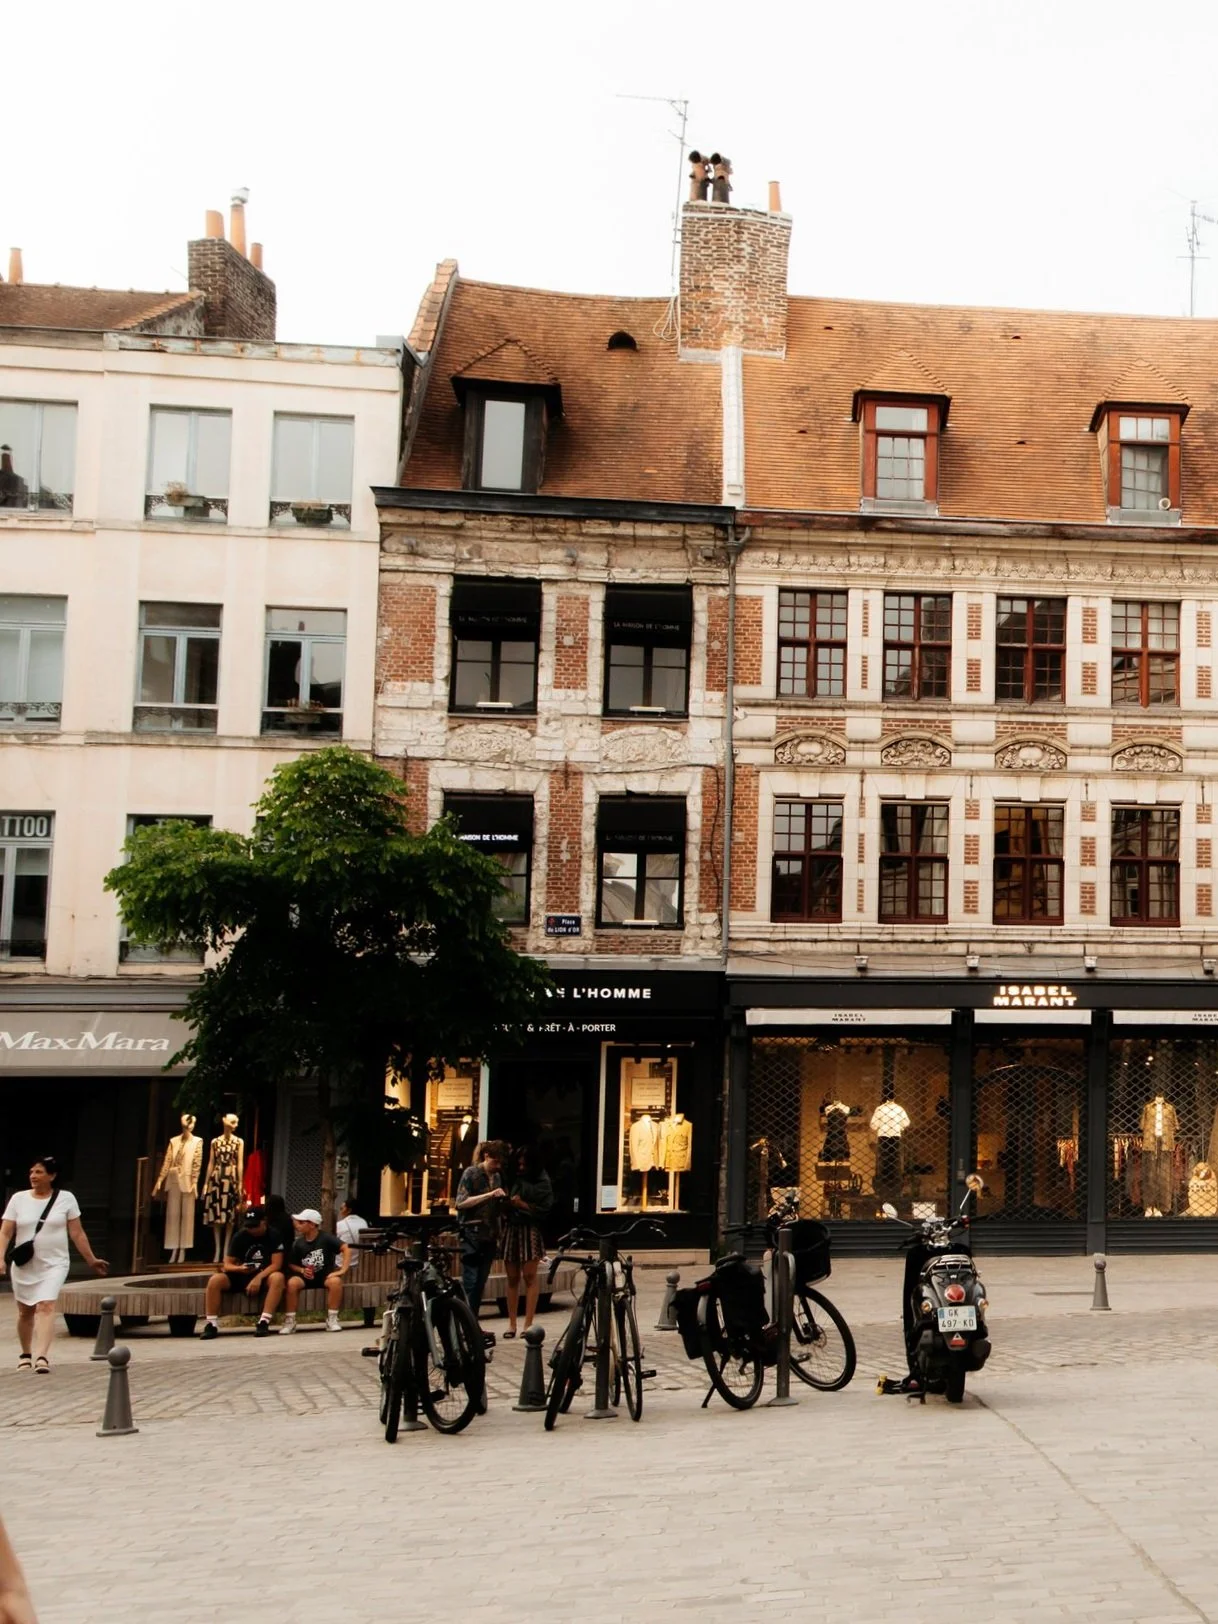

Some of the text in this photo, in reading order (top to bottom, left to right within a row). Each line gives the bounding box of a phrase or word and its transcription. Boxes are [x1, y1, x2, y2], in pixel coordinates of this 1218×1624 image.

[0, 816, 48, 837] TTOO
[573, 987, 652, 999] L'HOMME
[999, 985, 1072, 996] ISABEL
[993, 996, 1078, 1006] MARANT
[581, 1023, 616, 1032] PORTER
